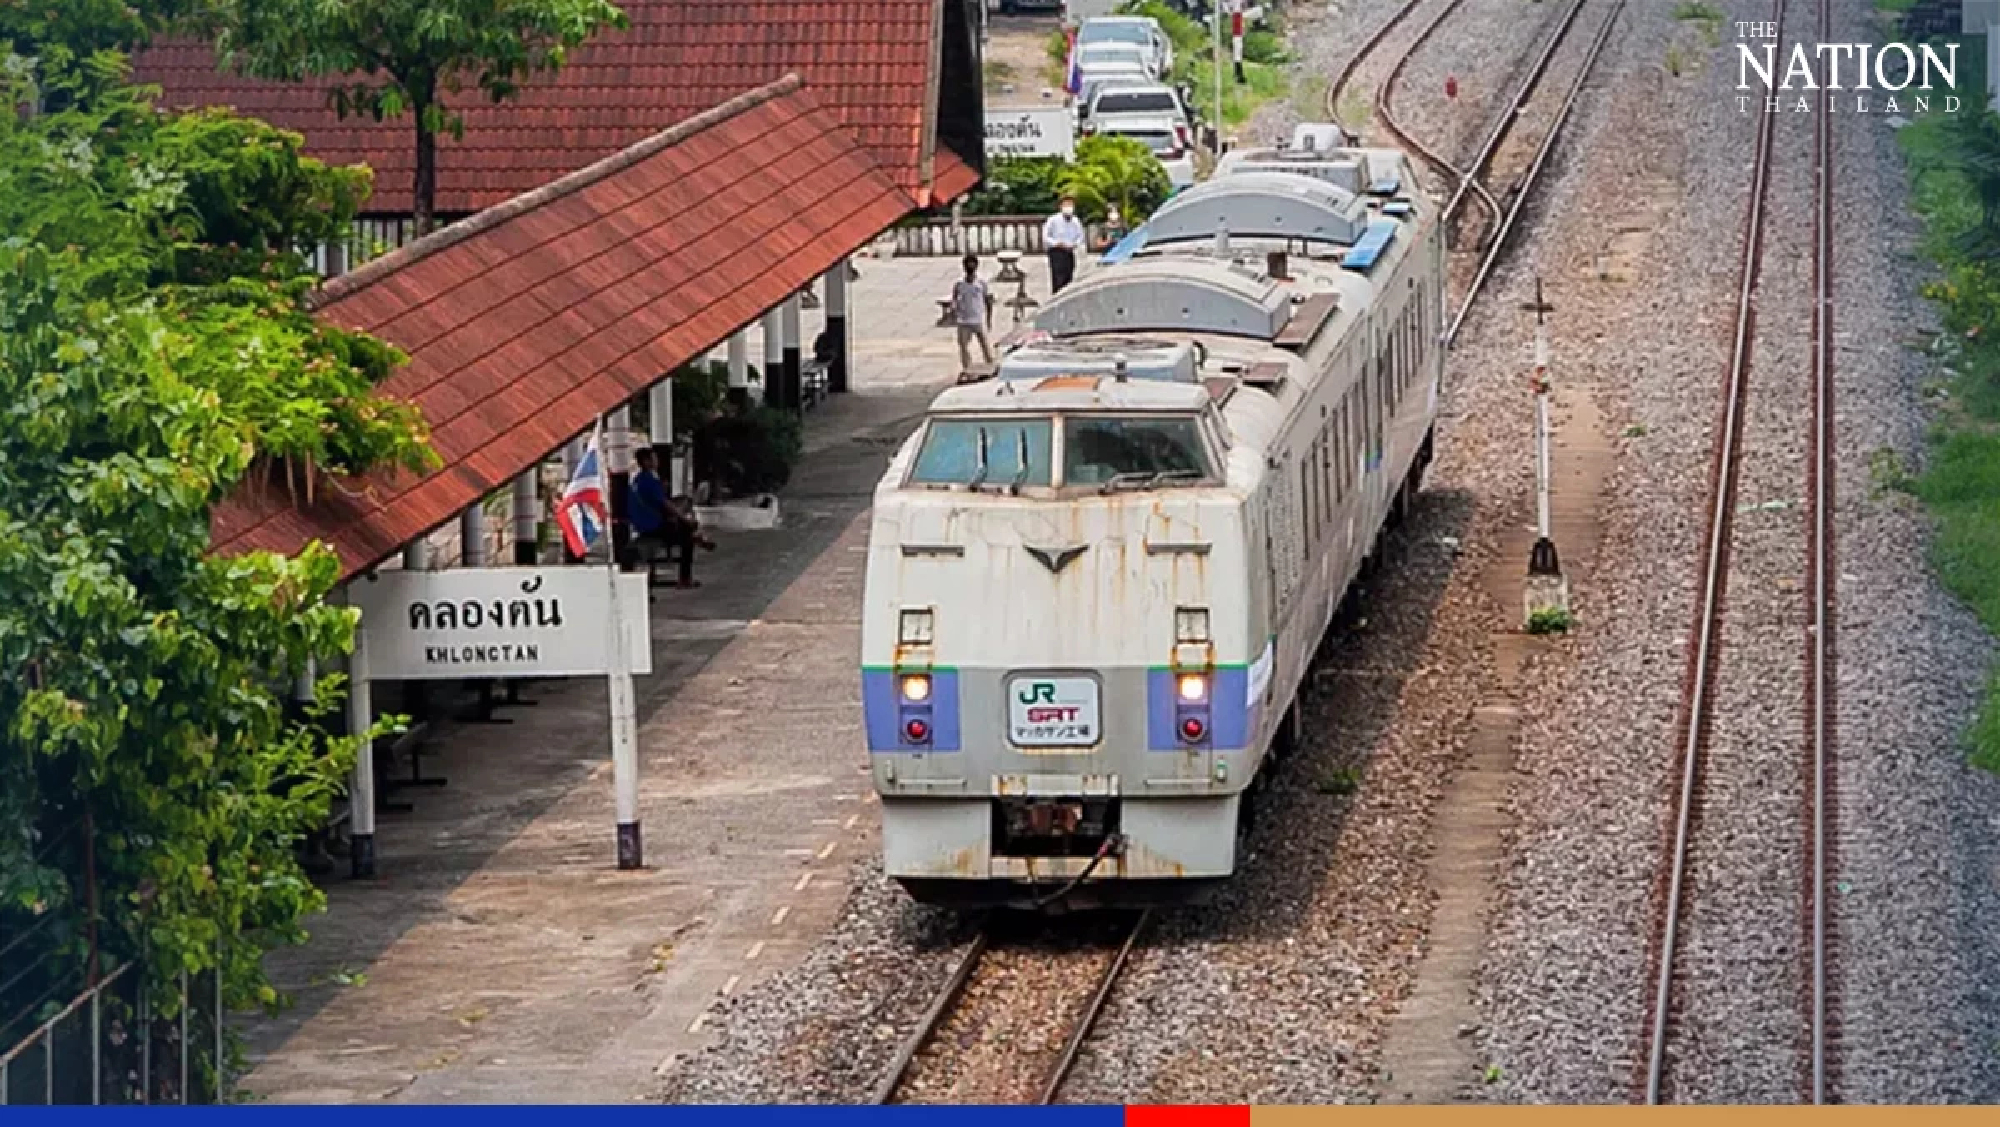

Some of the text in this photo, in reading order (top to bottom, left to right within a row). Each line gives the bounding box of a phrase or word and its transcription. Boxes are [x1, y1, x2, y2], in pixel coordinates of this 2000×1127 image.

[409, 575, 562, 629] คลองตัน
[1019, 683, 1055, 704] JR
[1027, 706, 1080, 722] SRT
